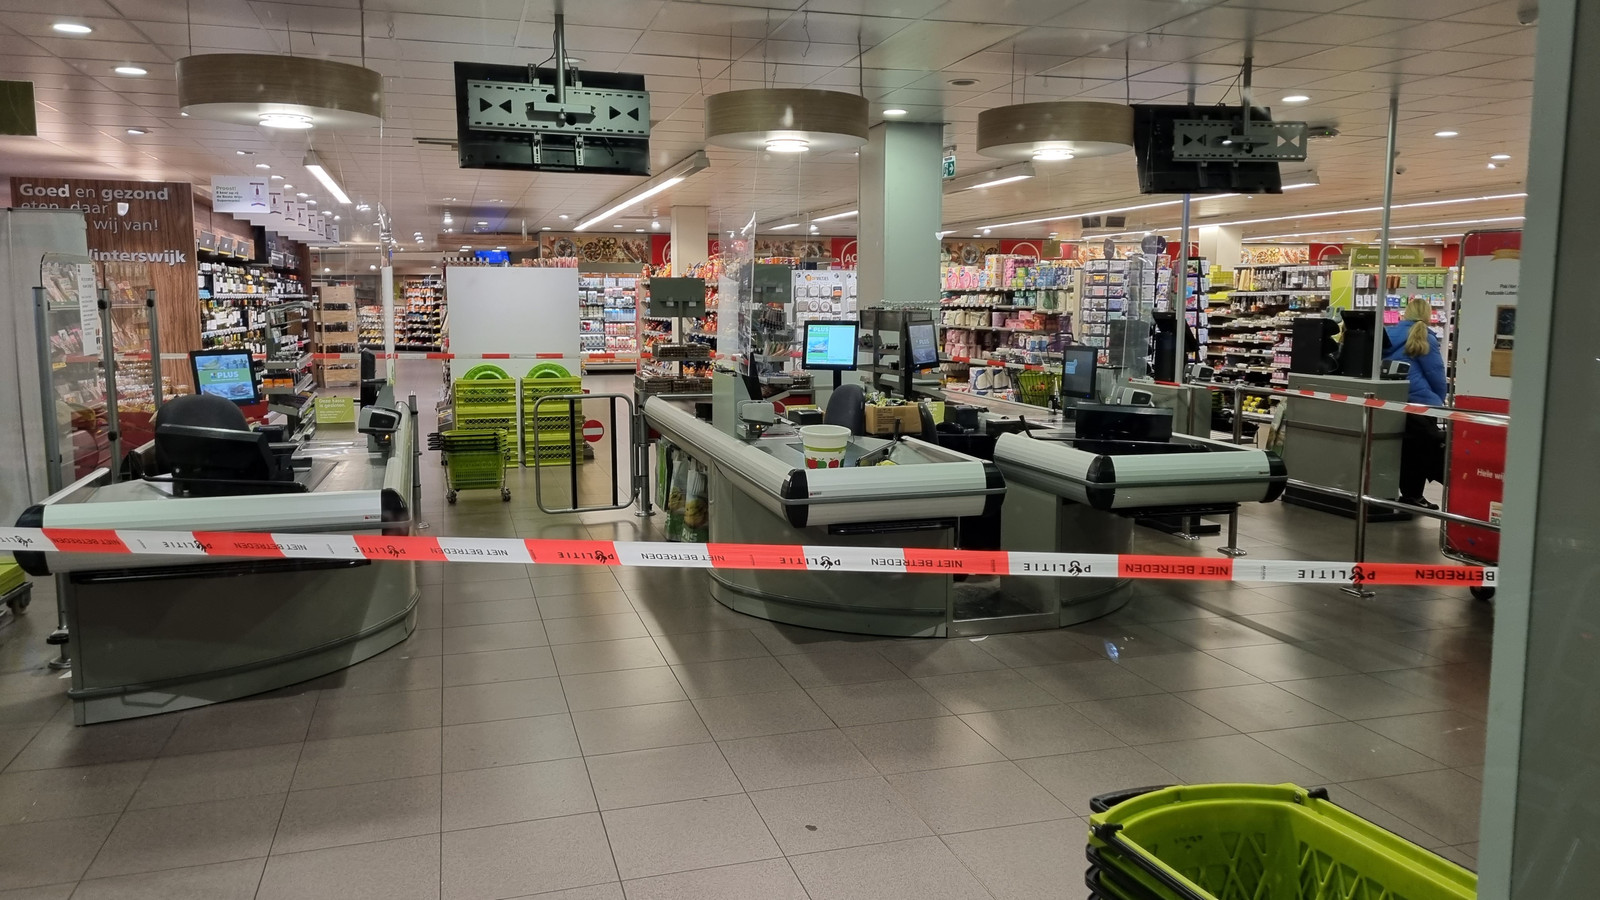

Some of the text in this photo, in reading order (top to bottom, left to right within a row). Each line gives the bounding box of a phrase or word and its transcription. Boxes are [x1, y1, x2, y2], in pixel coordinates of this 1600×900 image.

[19, 183, 169, 201] Goed en gezond
[70, 200, 108, 214] daar
[93, 217, 159, 233] wij van!
[89, 249, 186, 266] interswijk
[217, 371, 239, 379] PLUS
[52, 538, 122, 547] NIET BETREDEN
[233, 541, 285, 551] BETREDEN
[429, 546, 509, 556] NIET BETREDEN
[640, 552, 726, 561] NIET BETREDEN
[871, 557, 963, 568] NIET BETREDEN
[1125, 564, 1229, 576] NIET BETREDEN
[1414, 569, 1495, 581] BETREDEN
